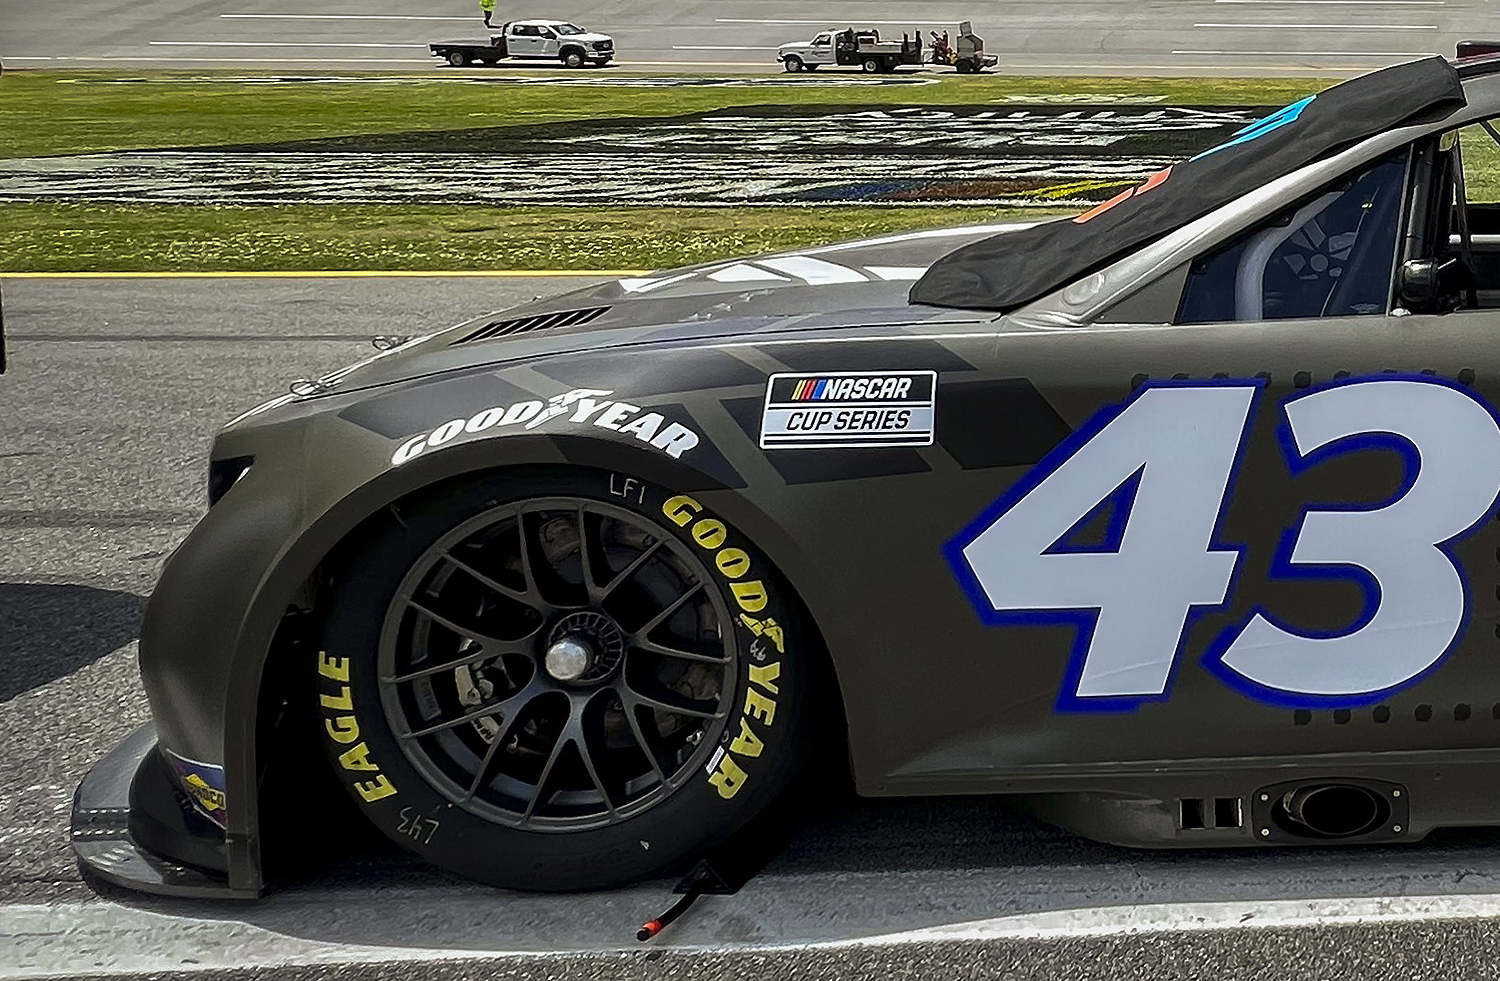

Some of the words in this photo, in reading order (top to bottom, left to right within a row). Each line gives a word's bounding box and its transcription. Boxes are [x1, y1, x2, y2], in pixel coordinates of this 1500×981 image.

[821, 377, 912, 401] NASCAR
[390, 387, 700, 467] GOODYEAR
[785, 412, 833, 431] CUP
[834, 409, 912, 430] SERIES
[318, 650, 398, 803] EAGLE
